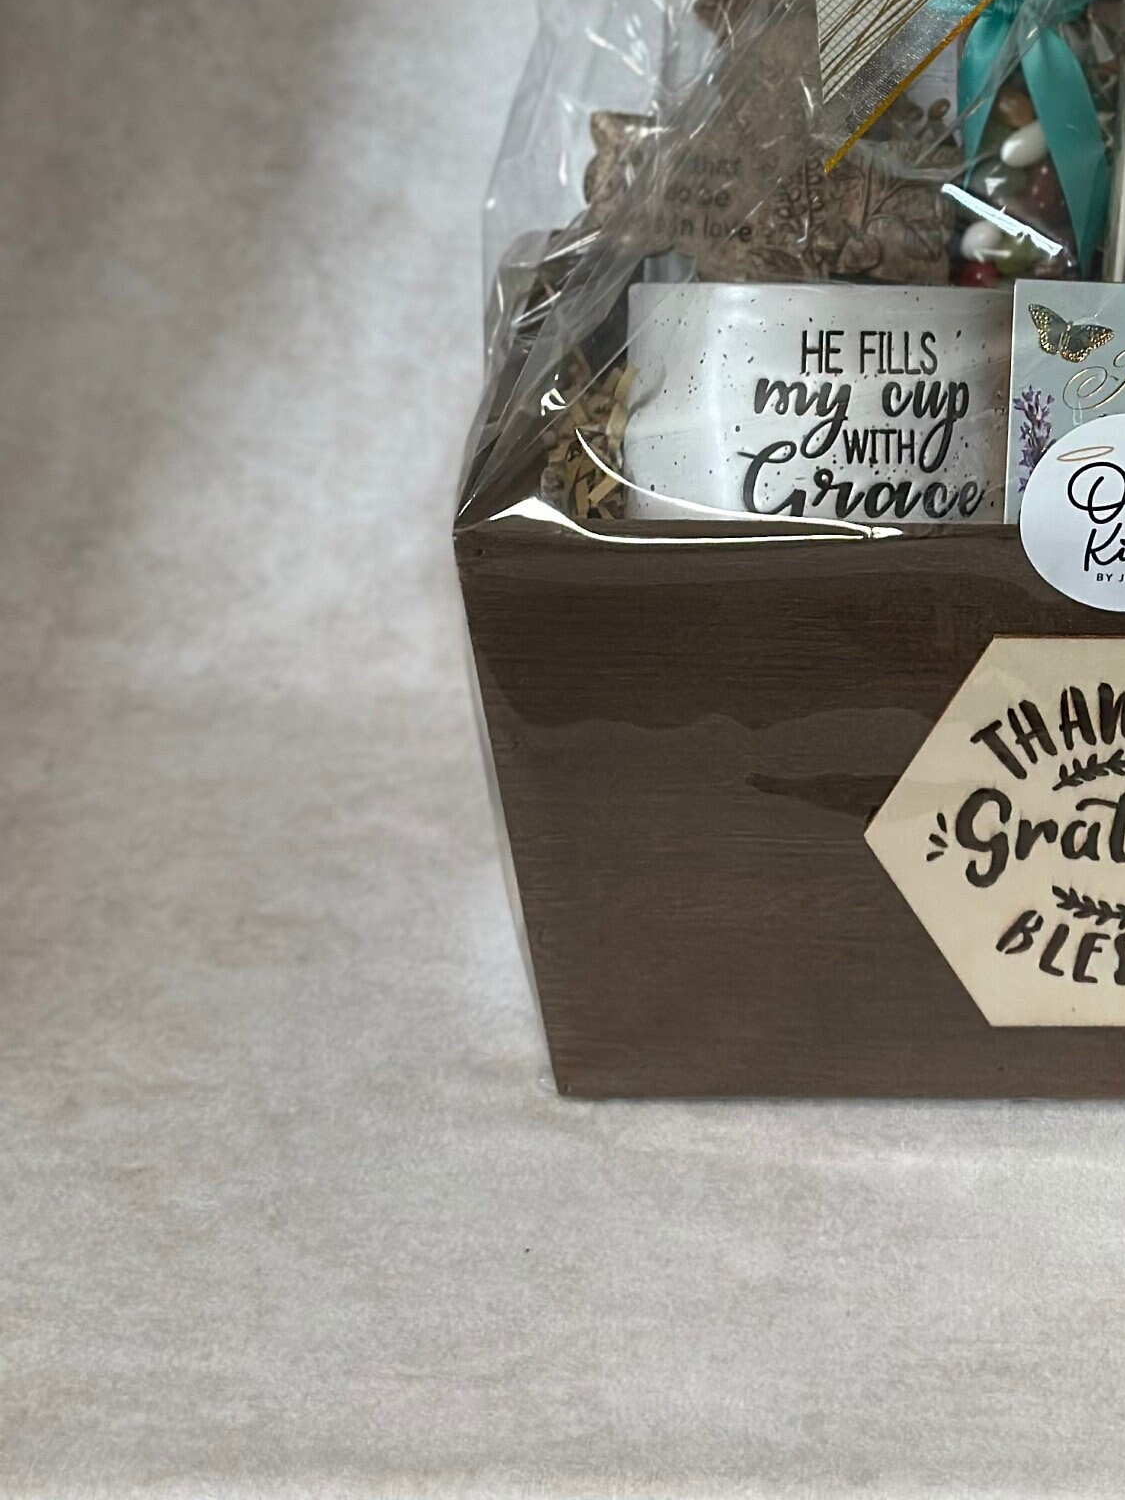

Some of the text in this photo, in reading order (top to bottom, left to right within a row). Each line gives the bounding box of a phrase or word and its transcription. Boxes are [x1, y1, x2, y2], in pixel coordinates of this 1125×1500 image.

[703, 215, 752, 242] love
[800, 330, 939, 376] HE FILLS
[754, 377, 971, 474] my cup
[842, 429, 916, 466] WITH
[737, 440, 985, 520] Grace
[1096, 572, 1114, 583] BY
